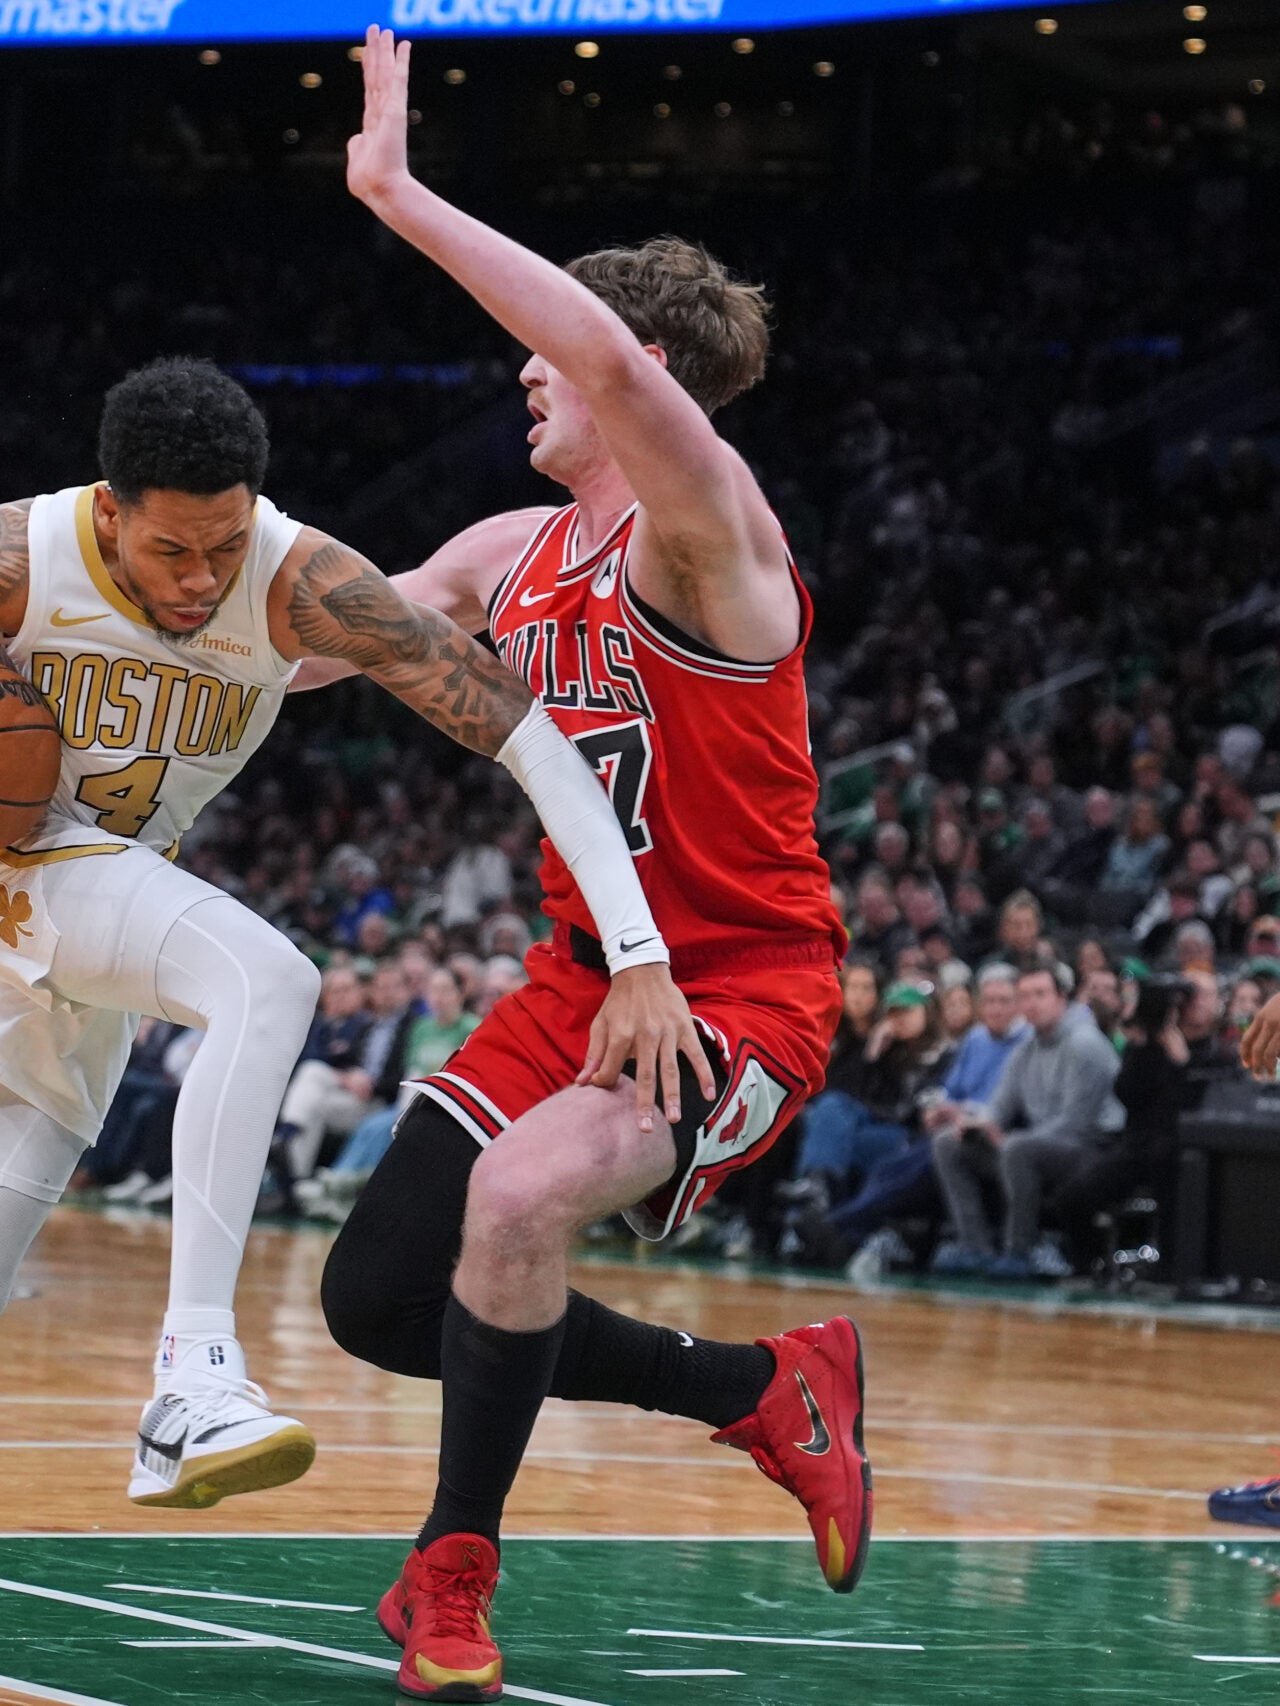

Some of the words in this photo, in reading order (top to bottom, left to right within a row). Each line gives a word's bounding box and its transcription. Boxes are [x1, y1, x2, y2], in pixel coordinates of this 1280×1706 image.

[190, 632, 252, 657] Amica
[32, 652, 263, 757] BOSTON
[74, 755, 171, 838] 4
